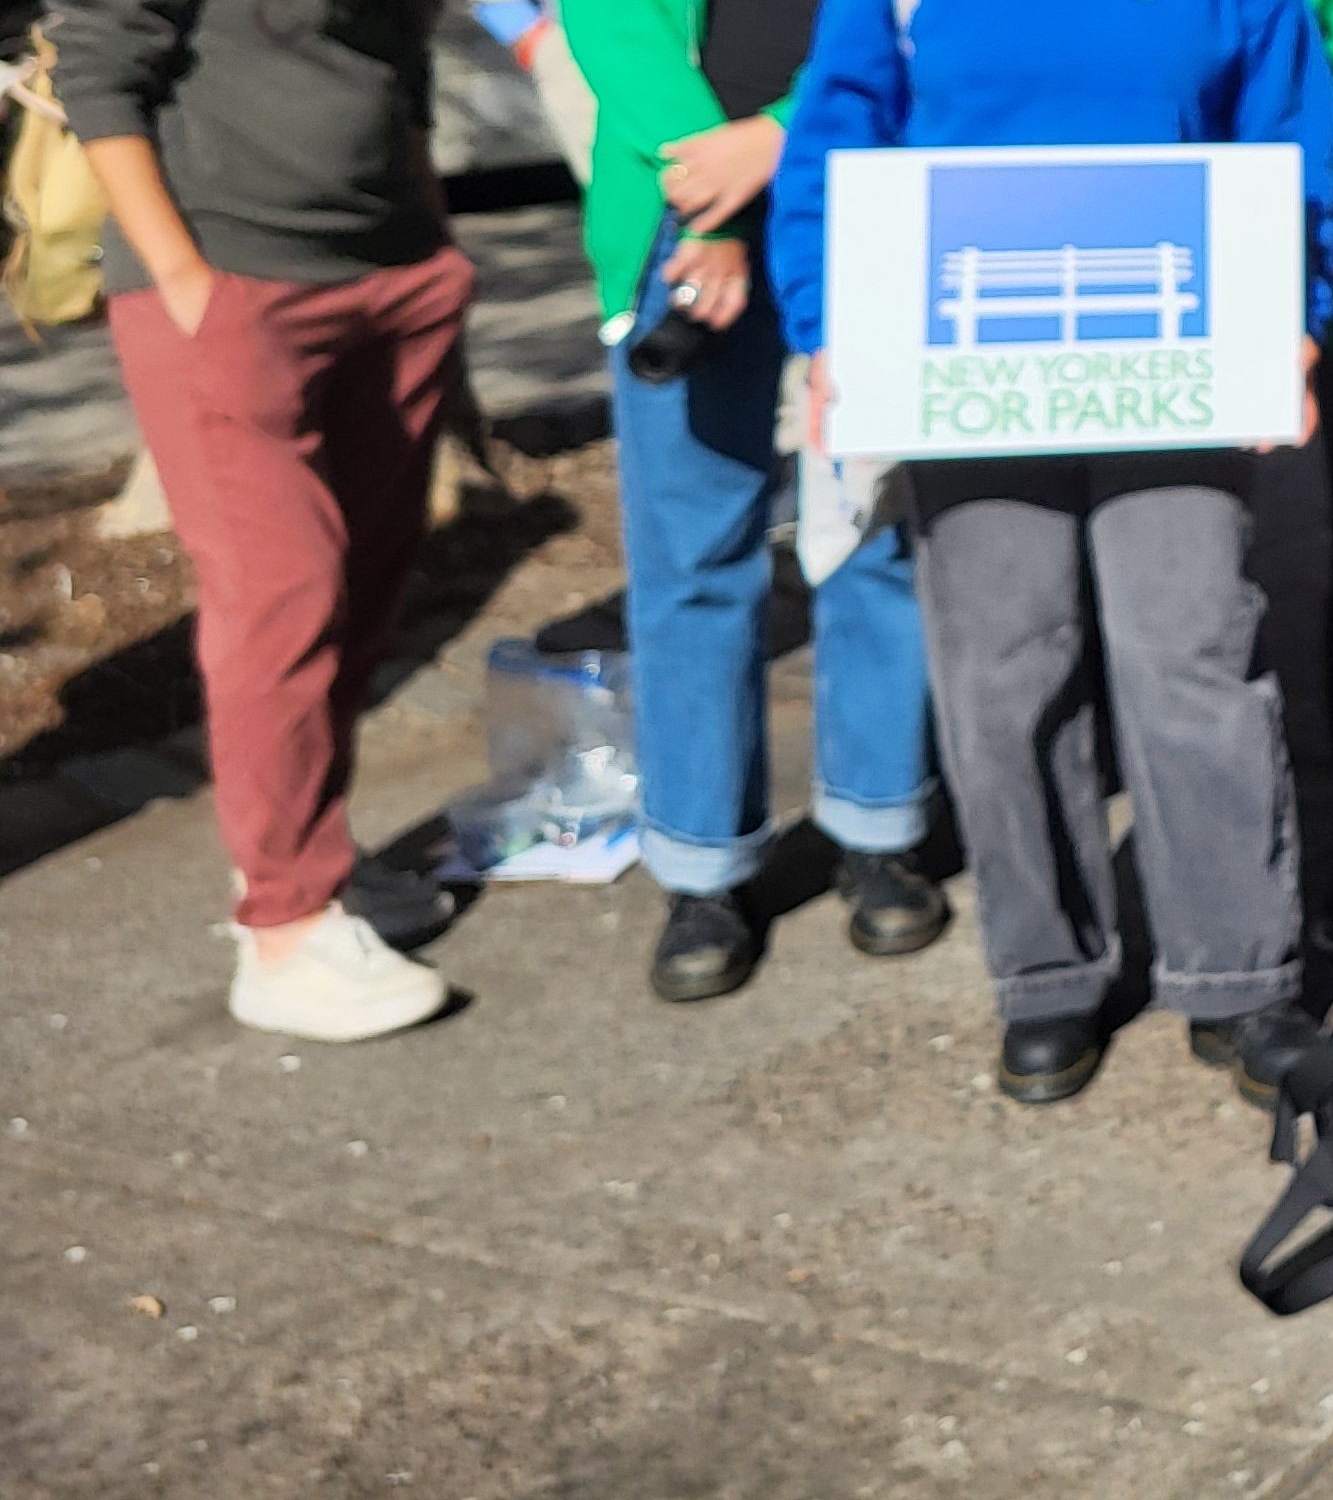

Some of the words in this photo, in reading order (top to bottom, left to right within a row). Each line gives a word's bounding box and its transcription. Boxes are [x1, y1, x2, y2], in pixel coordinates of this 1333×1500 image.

[921, 355, 1024, 389] NEW
[1036, 349, 1214, 385] YORKERS
[921, 390, 1033, 437] FOR
[1048, 383, 1214, 431] PARKS
